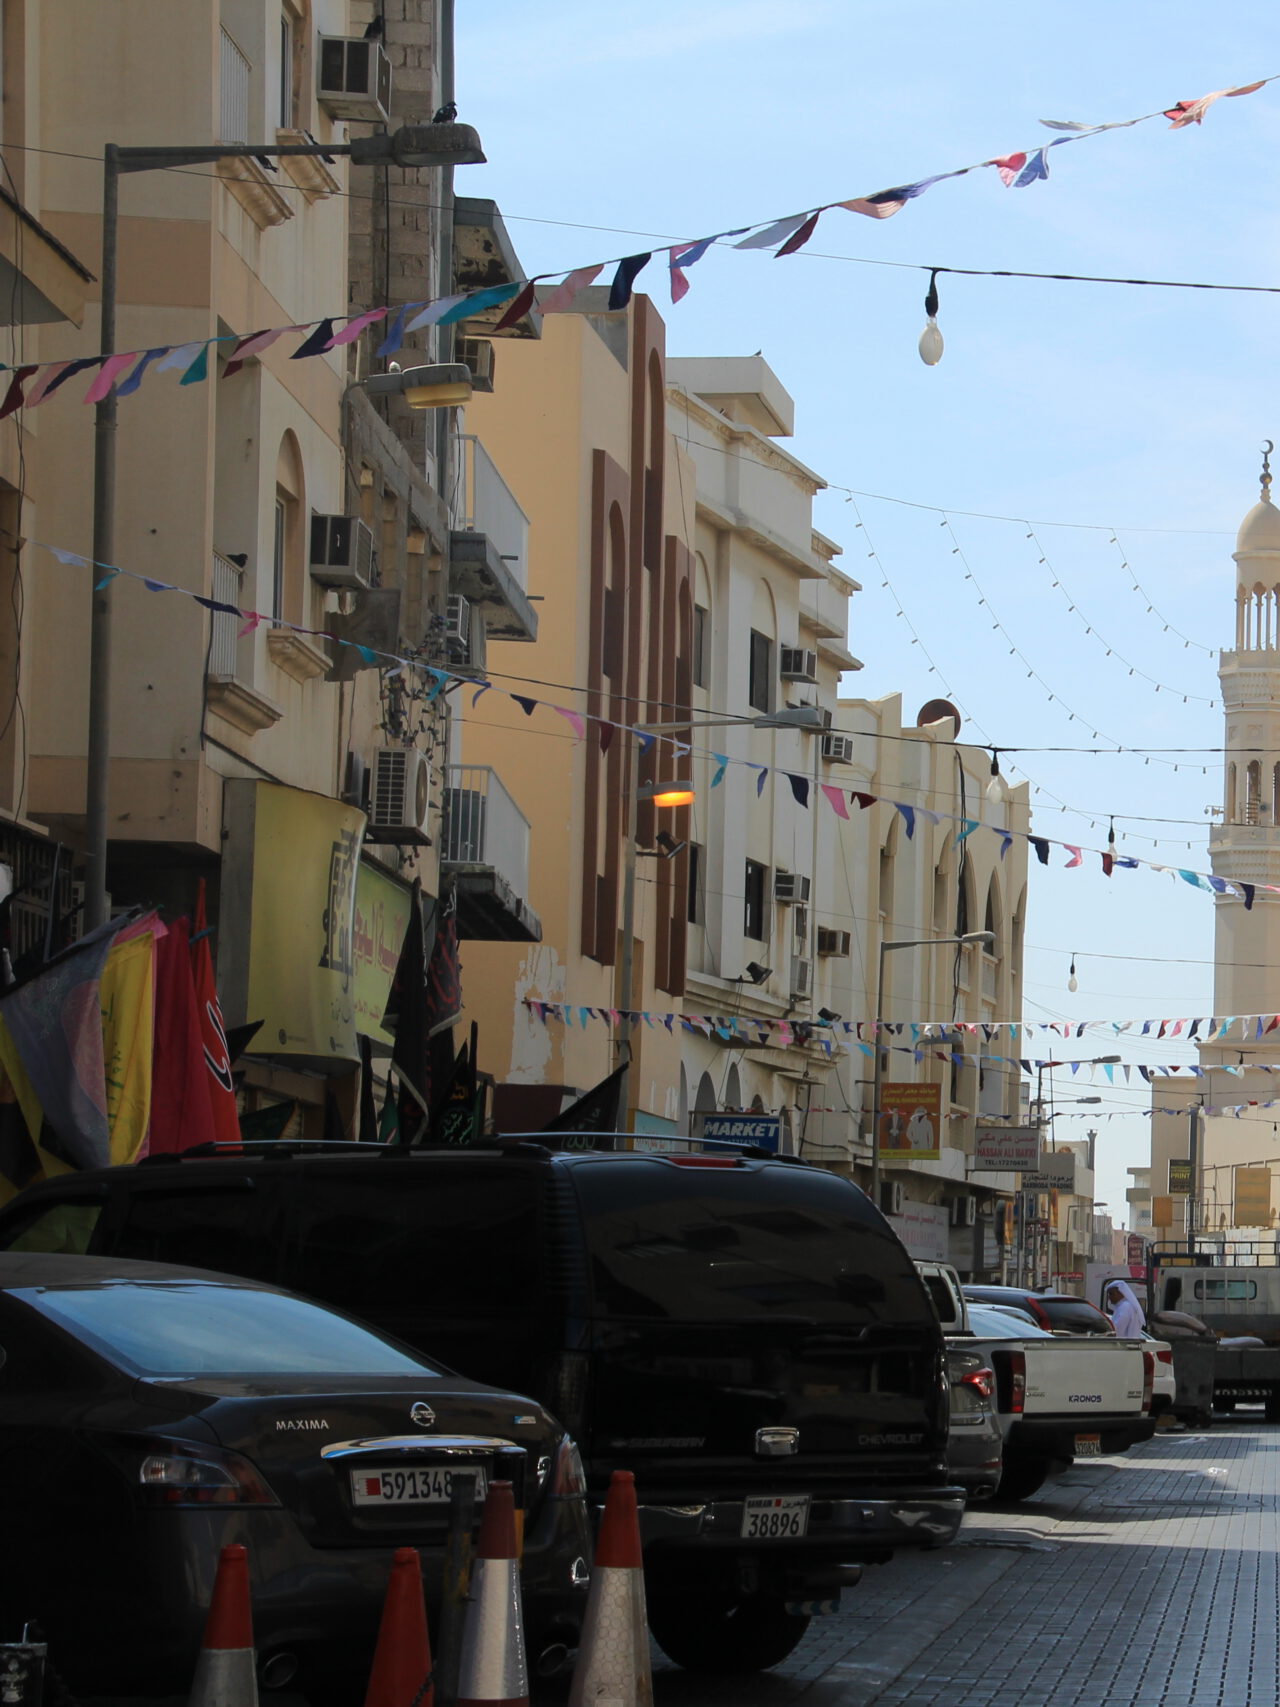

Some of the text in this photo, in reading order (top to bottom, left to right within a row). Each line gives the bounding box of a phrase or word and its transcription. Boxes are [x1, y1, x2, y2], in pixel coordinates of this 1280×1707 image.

[704, 1121, 779, 1137] MARKET
[1069, 1395, 1102, 1403] KRONOS
[276, 1419, 329, 1431] MAXIMA
[858, 1433, 924, 1445] CHEVROLET
[749, 1512, 800, 1537] 38896
